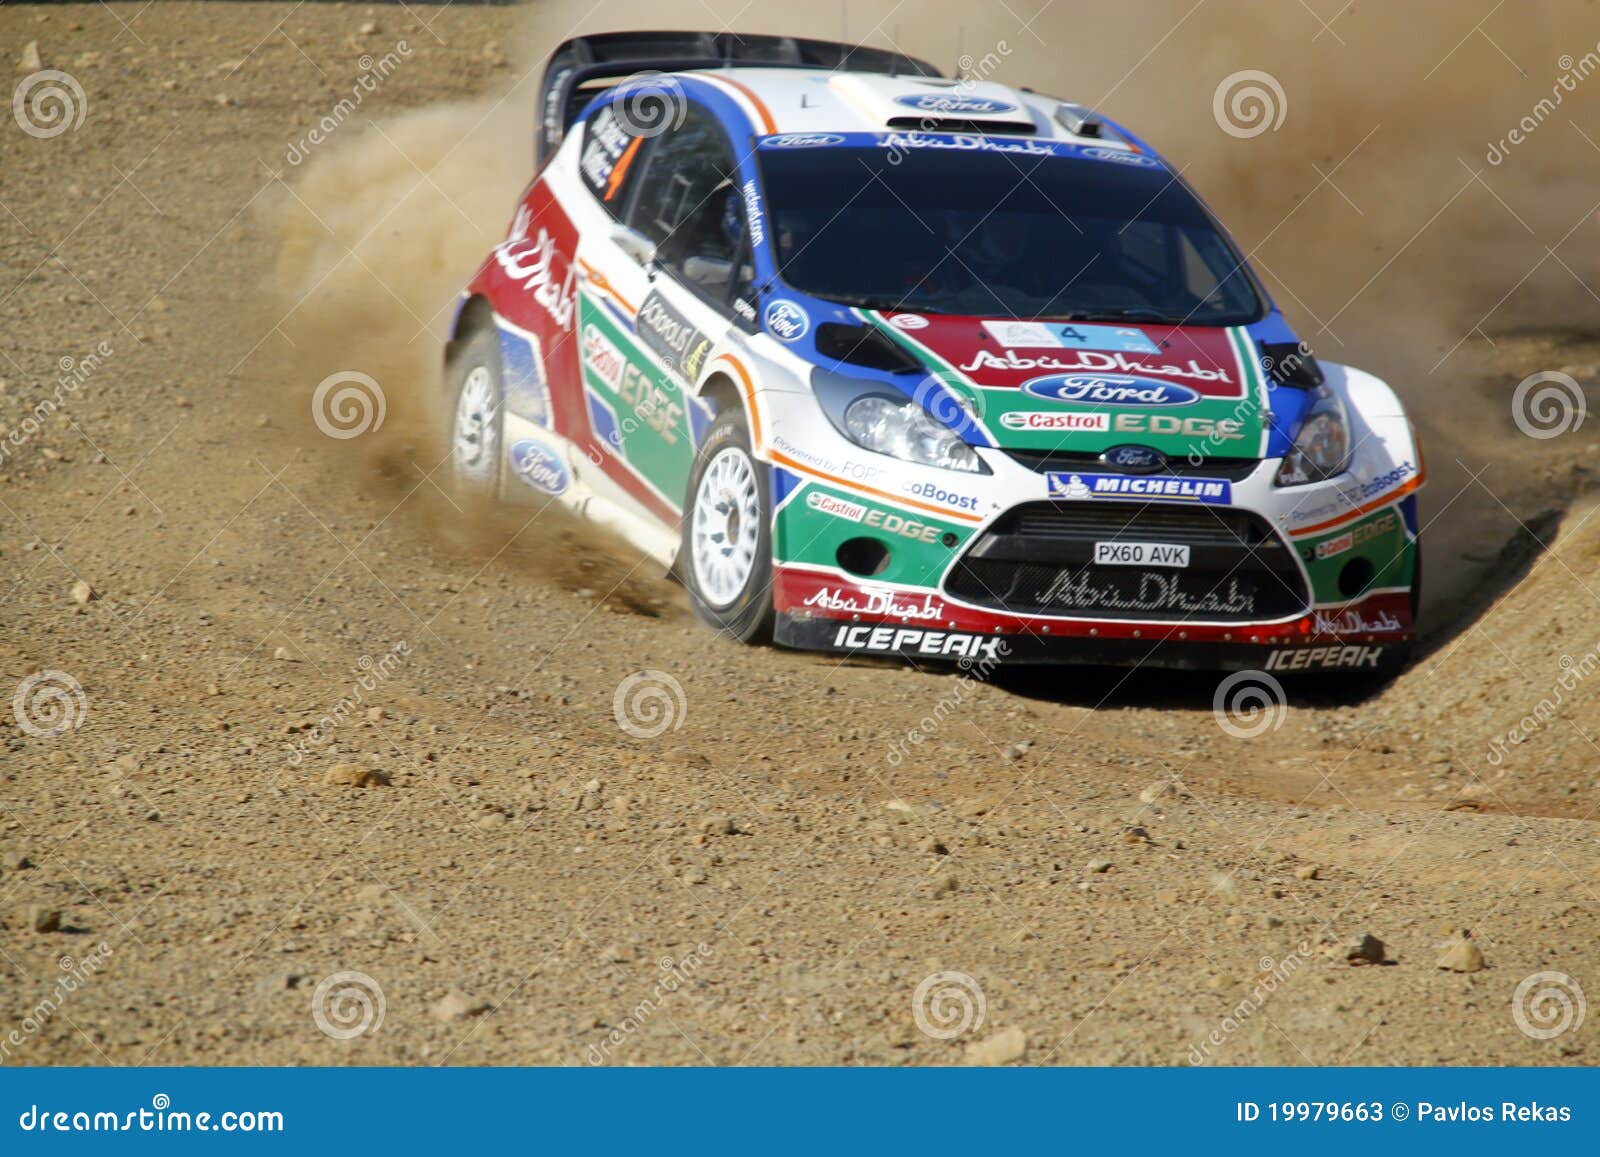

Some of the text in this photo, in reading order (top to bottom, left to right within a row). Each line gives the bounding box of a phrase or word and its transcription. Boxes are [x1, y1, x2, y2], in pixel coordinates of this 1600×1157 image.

[916, 95, 1000, 114] Ford
[951, 134, 1057, 157] Dhabi
[769, 304, 803, 339] Ford
[1060, 326, 1088, 343] 4
[960, 349, 1235, 384] Abu Dhabi
[1057, 376, 1170, 404] Ford
[1028, 413, 1247, 440] Castrol EDGE
[519, 446, 563, 490] Ford
[1116, 448, 1153, 465] Ford
[1094, 477, 1224, 497] MICHELIN
[819, 495, 944, 545] Castrol EDGE
[1098, 545, 1188, 564] PX60 AVK
[803, 585, 946, 621] Abu Dhabi
[1035, 569, 1255, 613] Abu Dhabi
[833, 625, 1001, 659] ICEPEAK
[1264, 645, 1384, 672] ICEPEAK
